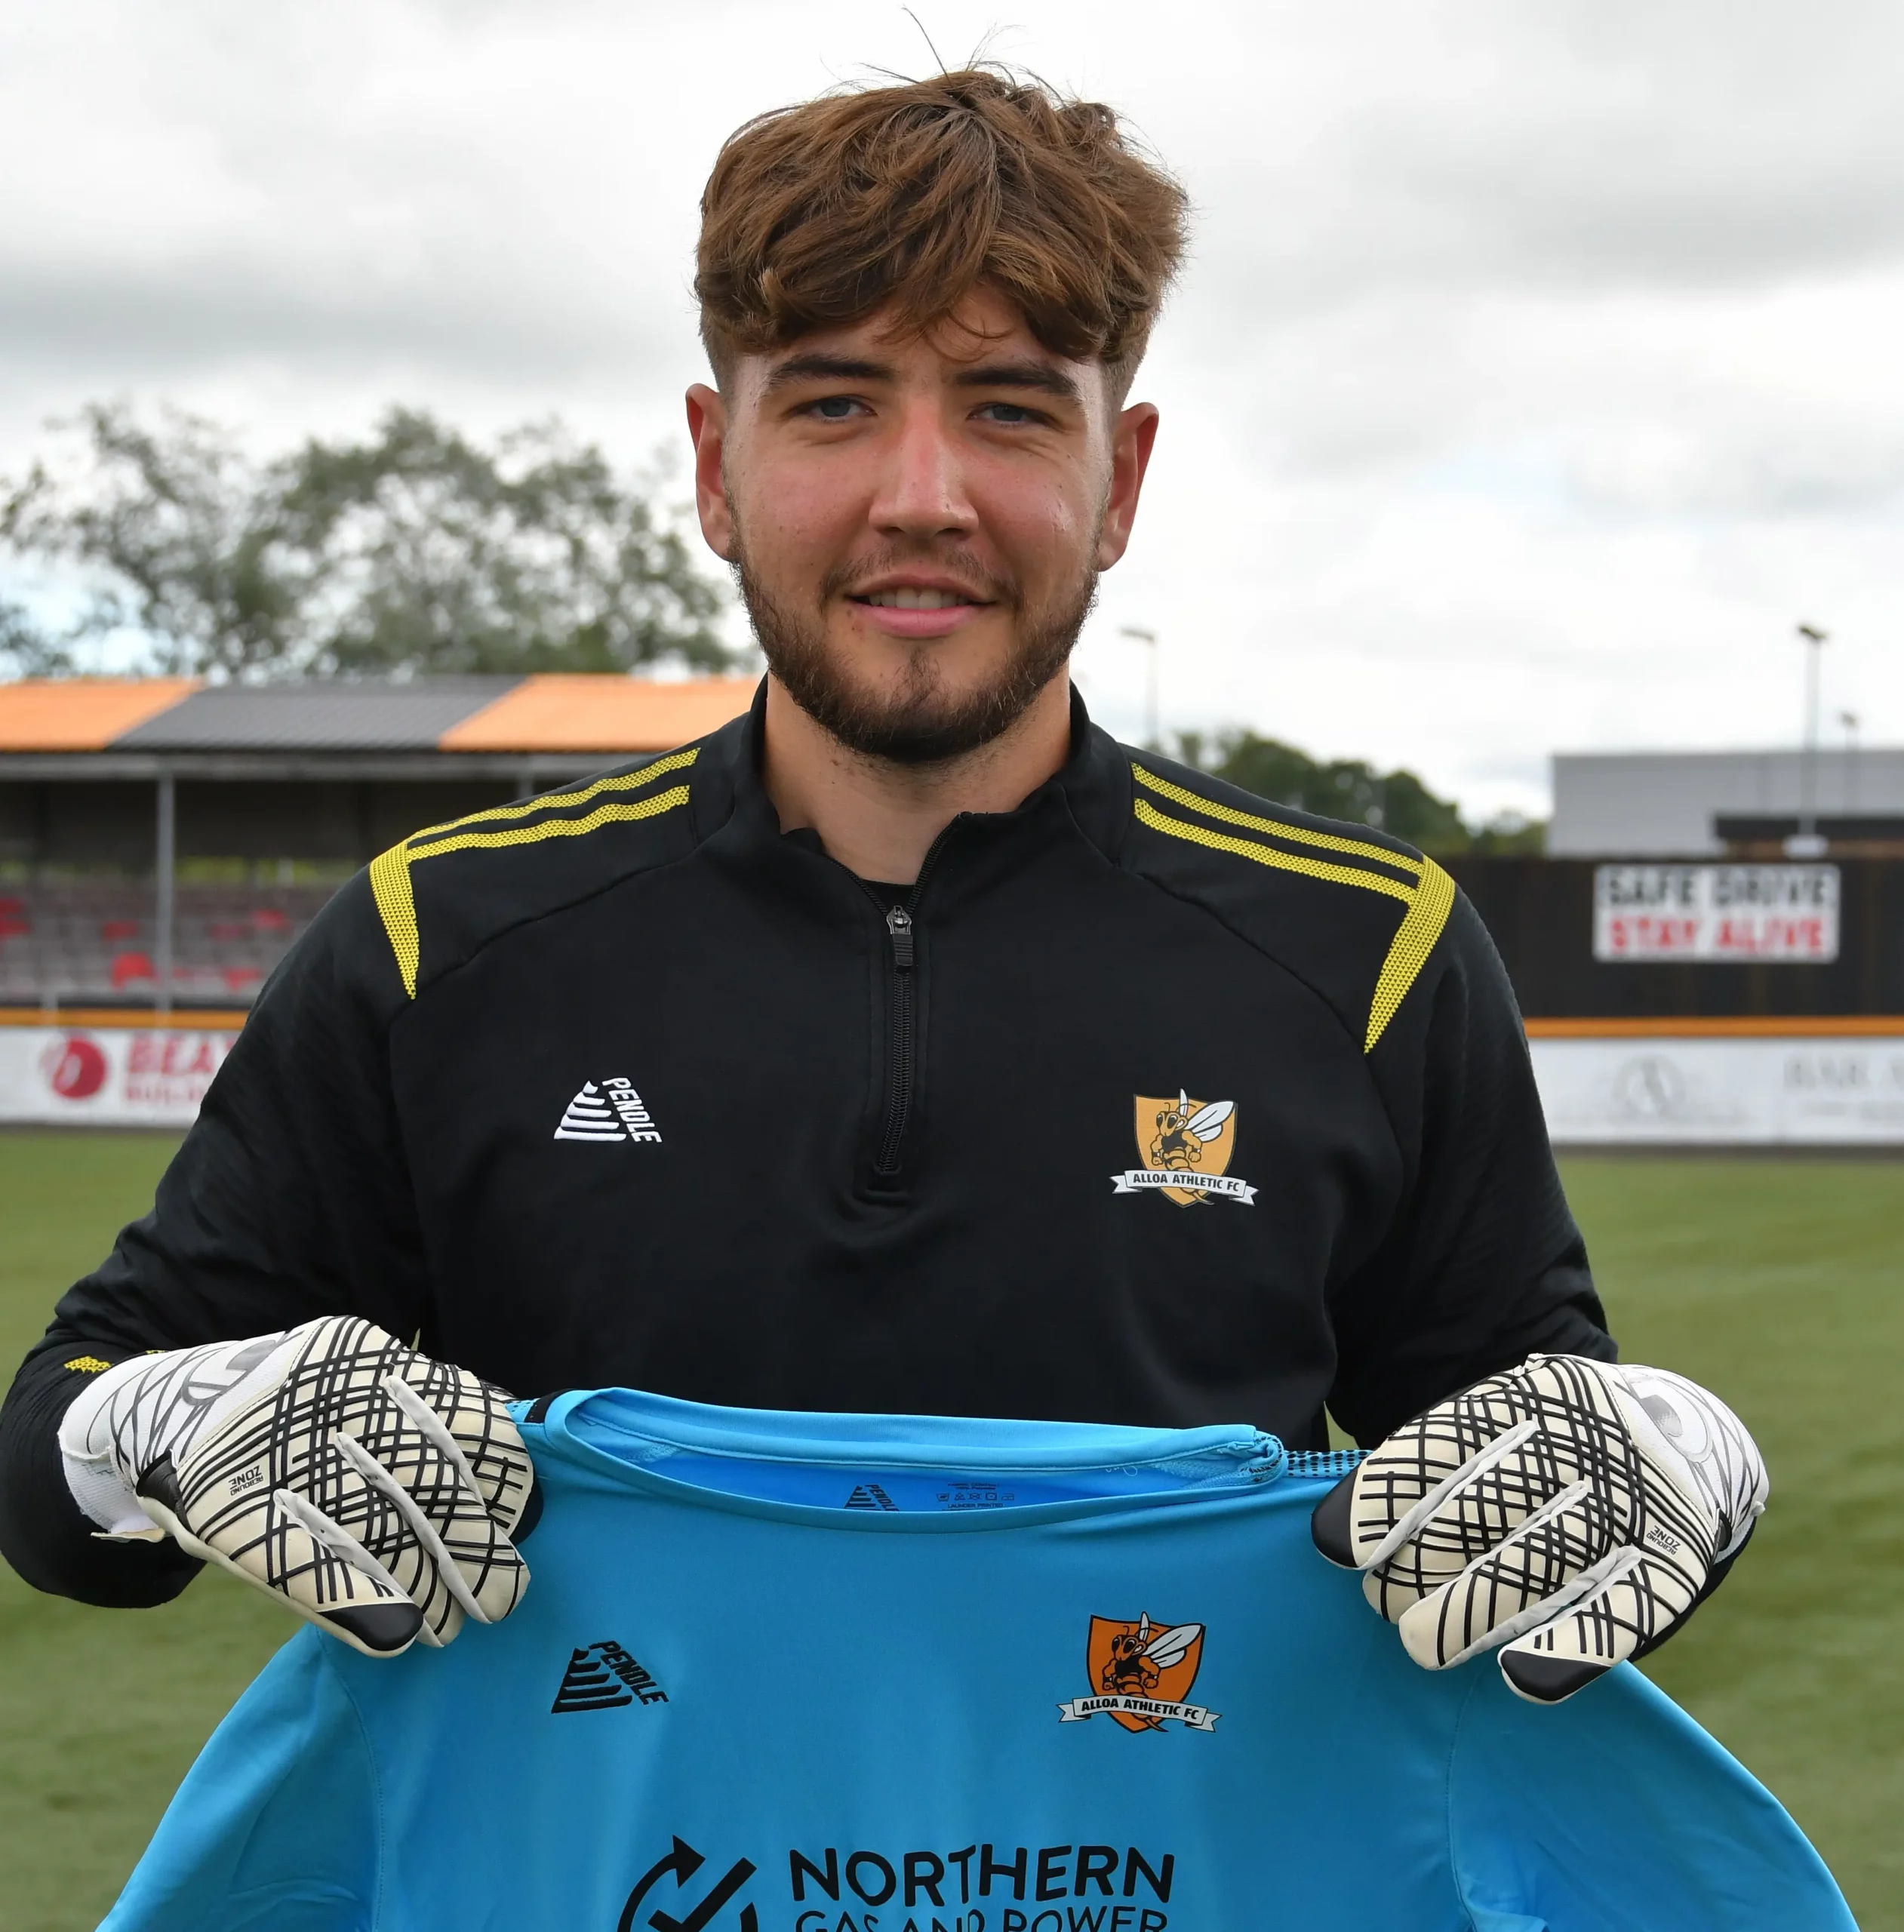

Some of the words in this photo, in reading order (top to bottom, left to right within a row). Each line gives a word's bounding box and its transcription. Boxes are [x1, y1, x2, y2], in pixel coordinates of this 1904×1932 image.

[1606, 869, 1698, 907] SAFE
[1715, 869, 1829, 907] DRIVE
[1608, 915, 1699, 953] STAY
[1715, 915, 1826, 955] ALIVE
[602, 1077, 663, 1143] PENDLE
[1133, 1174, 1168, 1183] ALLOA
[1172, 1174, 1223, 1189] ATHLETIC
[1226, 1181, 1239, 1192] FC
[228, 1465, 262, 1490] ZONE
[230, 1475, 263, 1496] REBOUND
[1646, 1532, 1676, 1555] REBOUND
[1650, 1525, 1681, 1550] ZONE
[588, 1640, 669, 1706] PENDLE
[1081, 1699, 1119, 1712] ALLOA
[1124, 1700, 1181, 1715] ATHLETIC
[1184, 1709, 1200, 1720] FC
[789, 1844, 1175, 1906] NORTHERN
[1003, 1906, 1167, 1932] POWER
